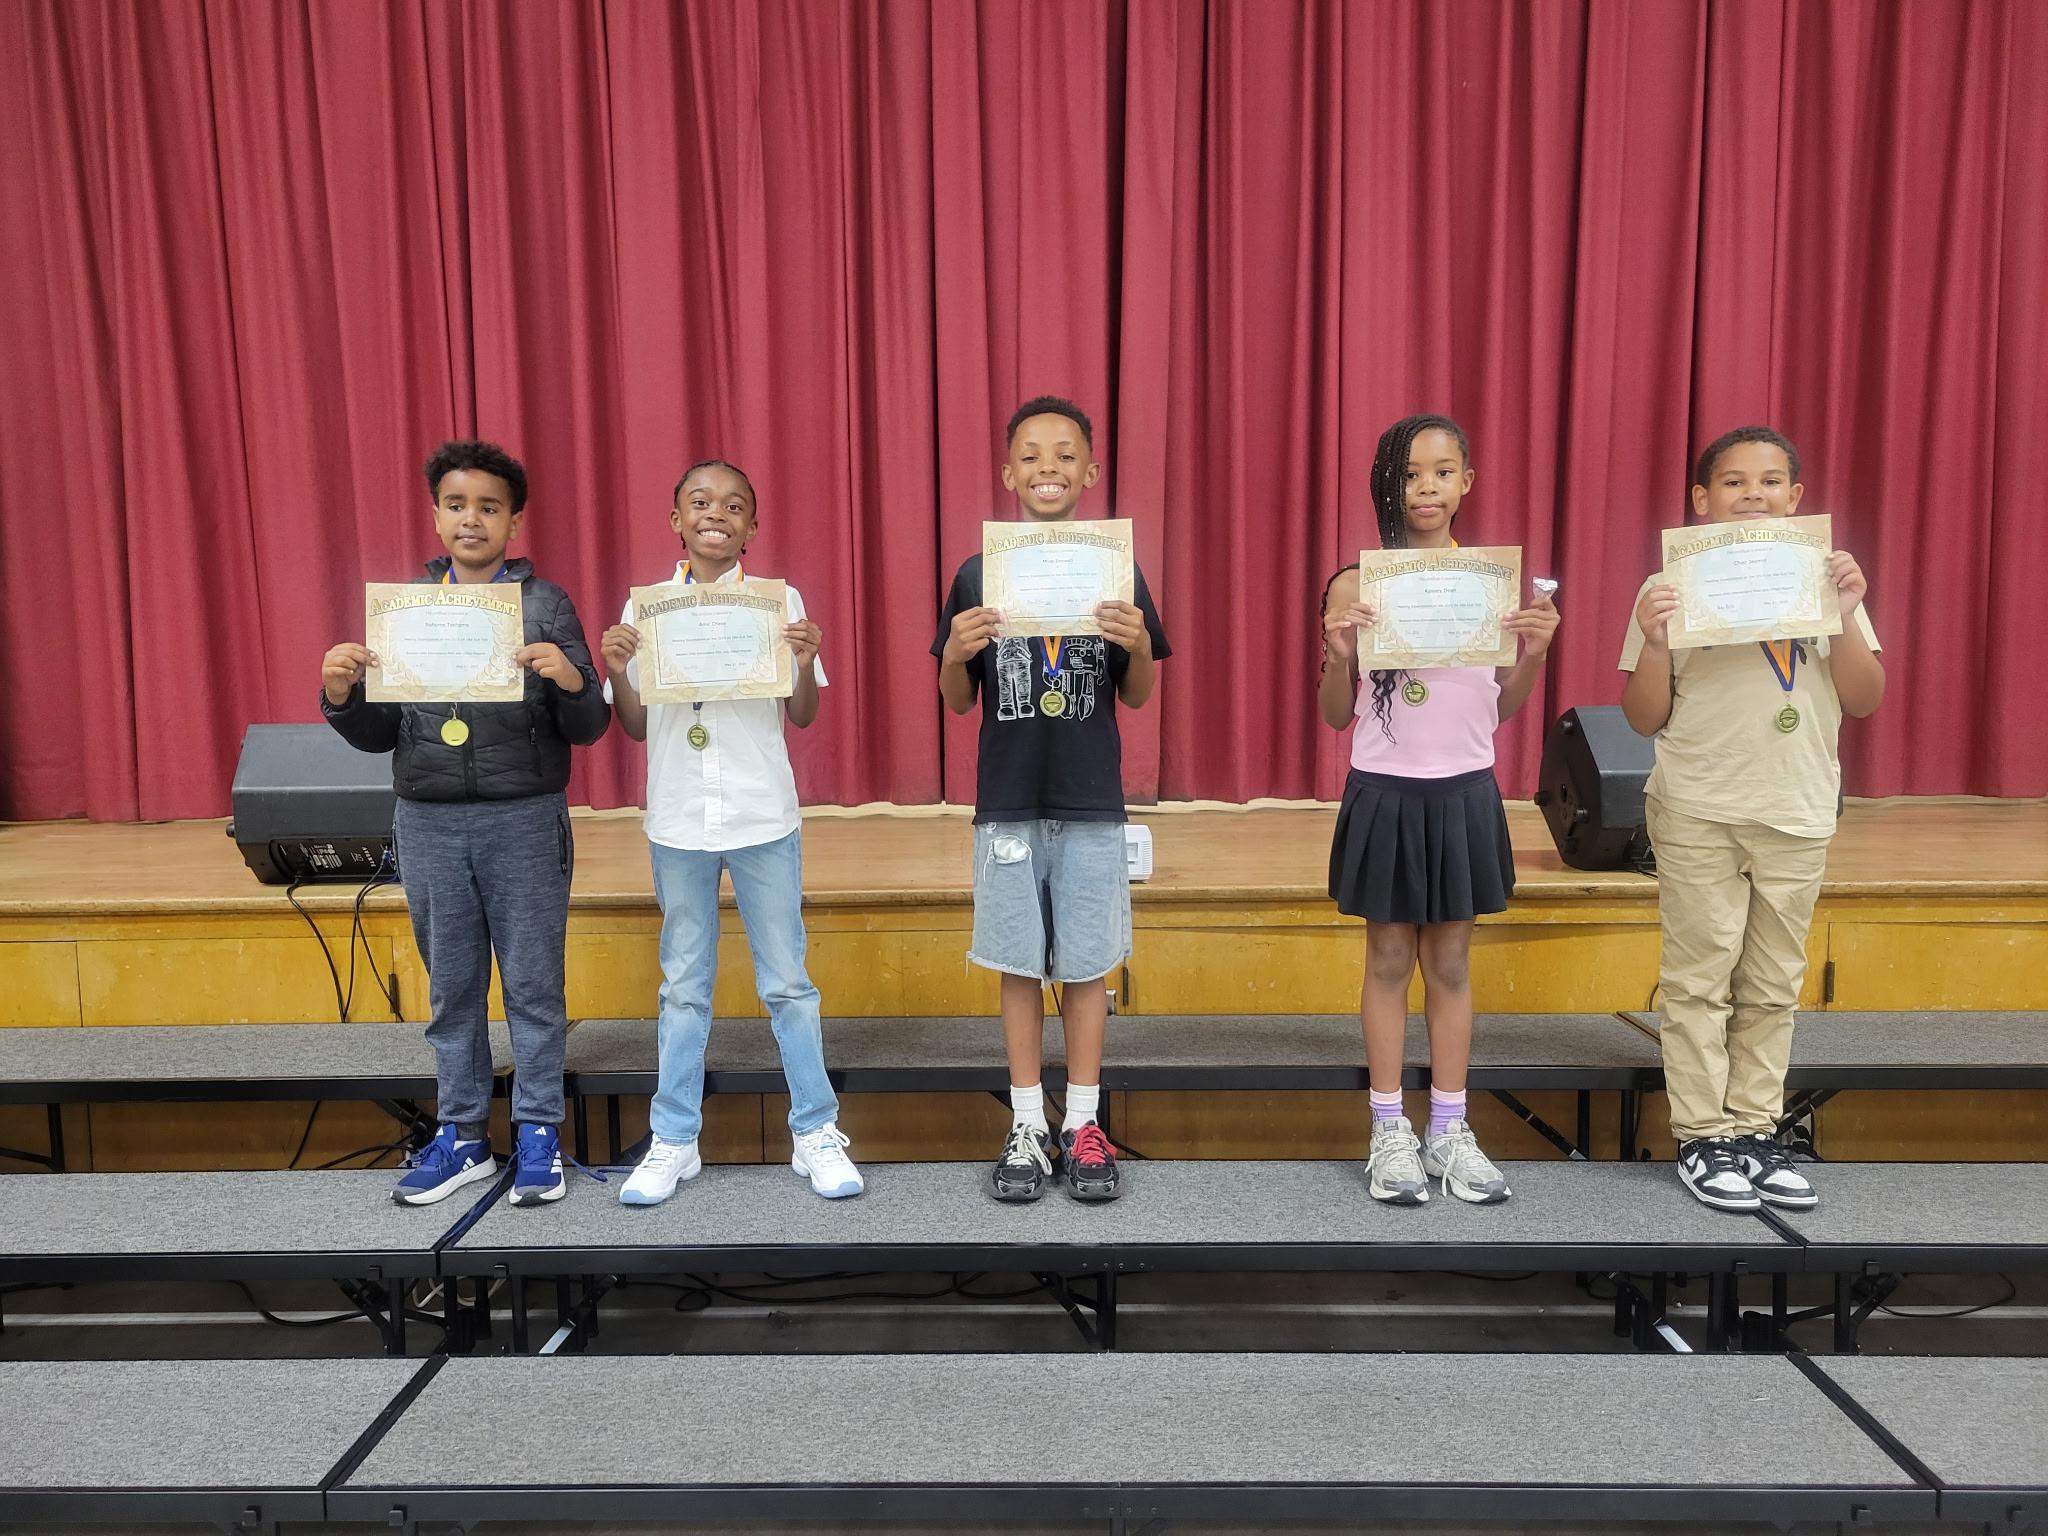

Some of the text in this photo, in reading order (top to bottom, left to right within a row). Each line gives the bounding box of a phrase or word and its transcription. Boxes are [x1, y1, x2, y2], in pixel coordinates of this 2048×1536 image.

[986, 532, 1045, 556] ACADEMIC
[1666, 532, 1735, 563] ACADEMIC
[1362, 553, 1515, 585] ACADEMIC ACHIEVEMENT
[637, 590, 783, 622] ACADEMIC ACHIEVEMENT
